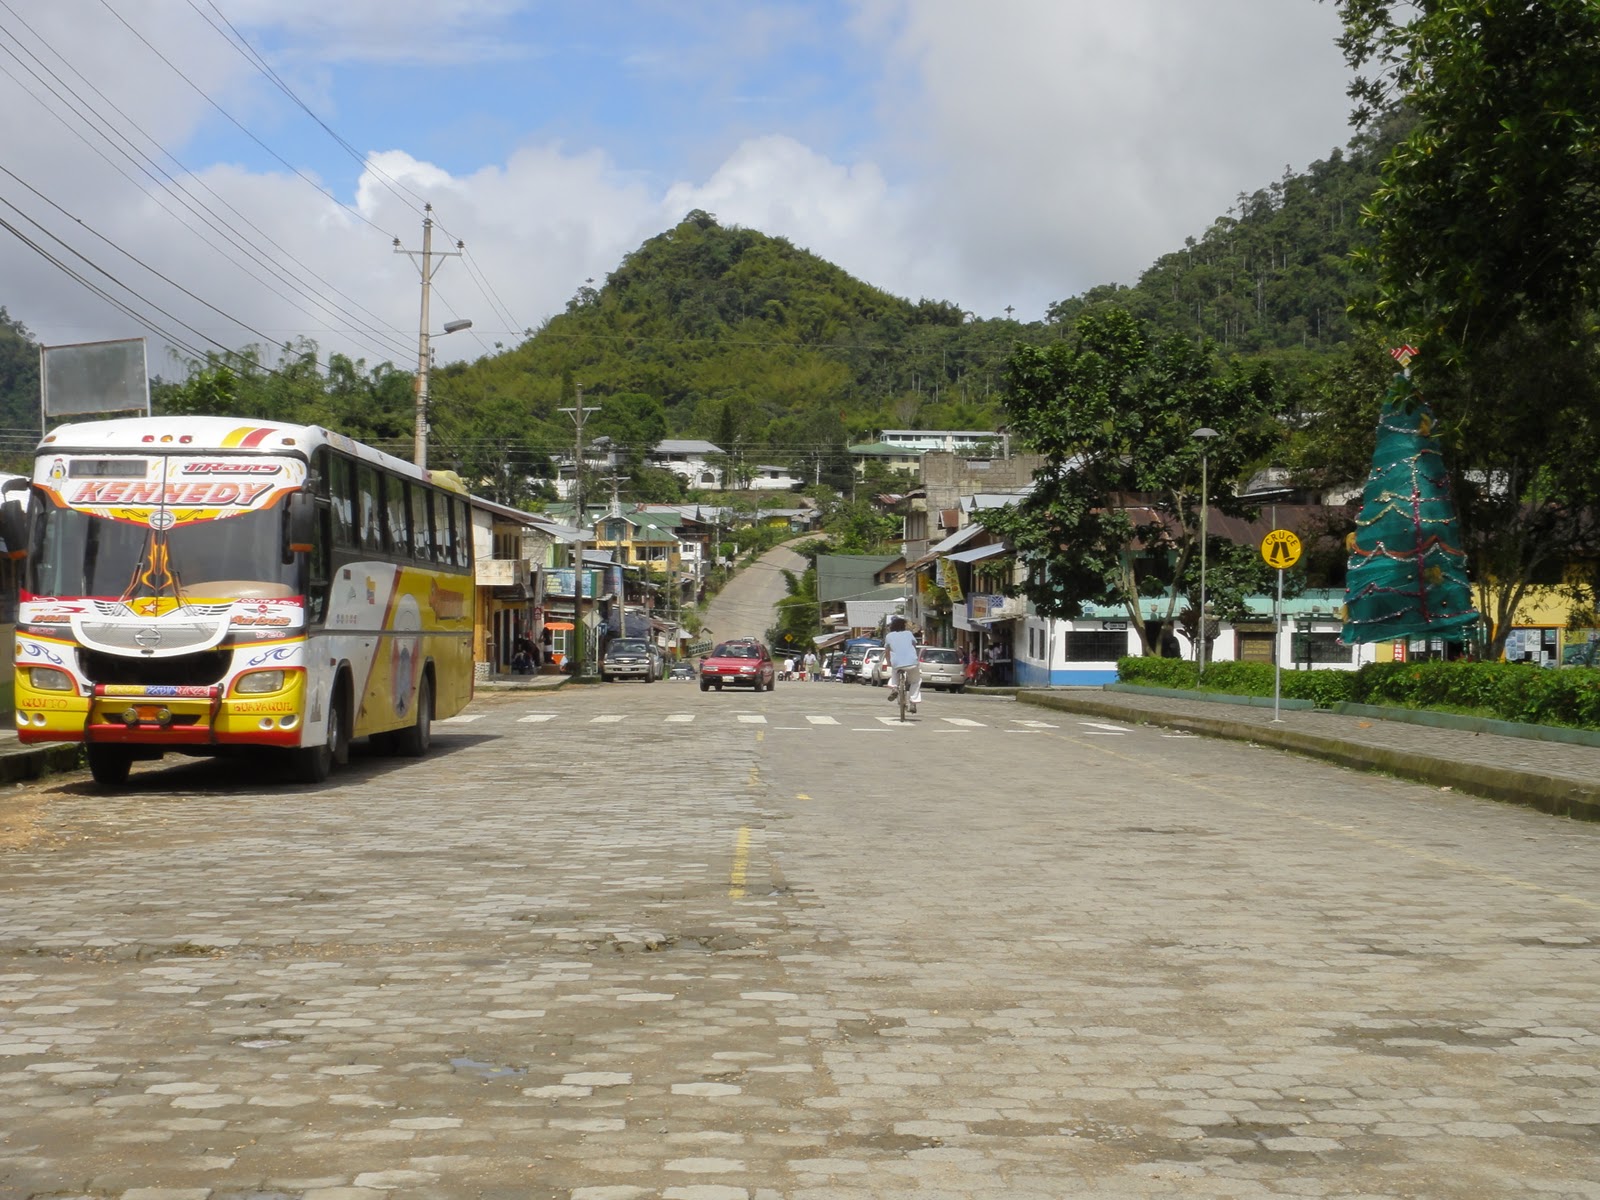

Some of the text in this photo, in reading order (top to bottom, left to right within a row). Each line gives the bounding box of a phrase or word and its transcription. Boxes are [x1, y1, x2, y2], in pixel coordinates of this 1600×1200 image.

[69, 482, 274, 505] KENNEDY
[1265, 531, 1298, 547] CRUCE
[22, 698, 68, 708] QUITO
[234, 702, 293, 712] GUAYAQUIL
